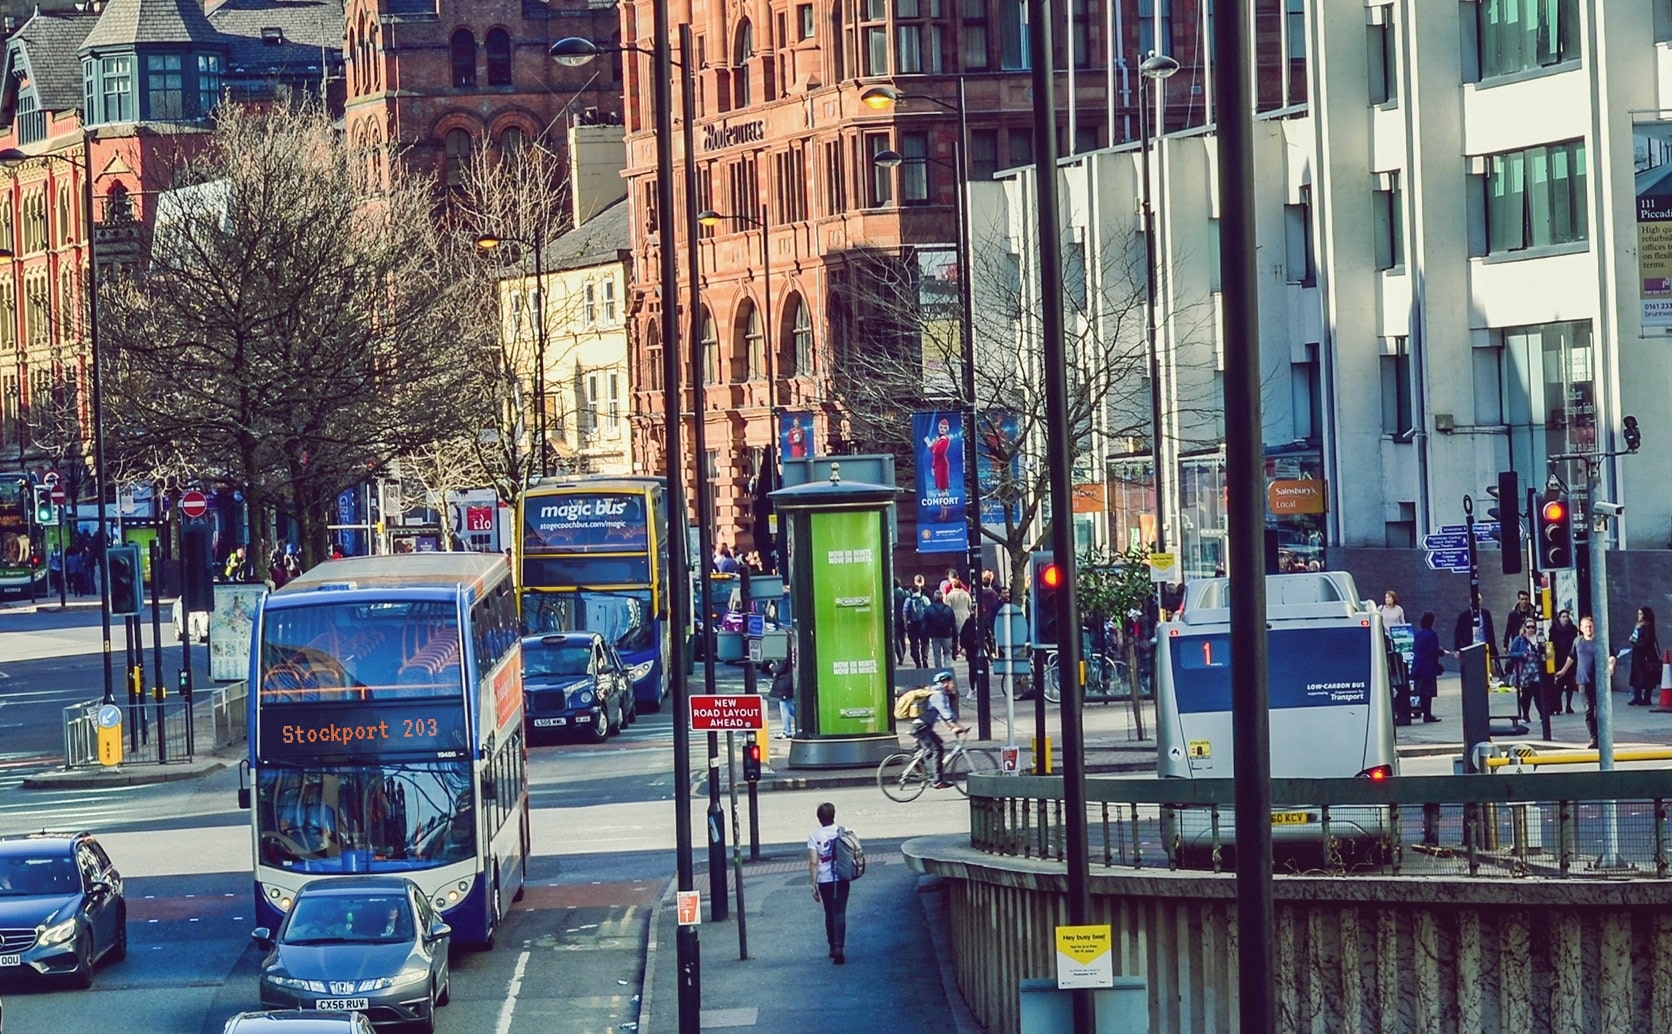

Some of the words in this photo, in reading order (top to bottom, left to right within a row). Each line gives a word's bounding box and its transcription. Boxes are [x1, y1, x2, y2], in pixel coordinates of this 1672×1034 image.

[1642, 200, 1654, 208] 111
[1642, 226, 1660, 234] High
[1276, 487, 1316, 496] Sainsbury's
[922, 497, 958, 506] COMFORT
[541, 500, 591, 520] magic
[595, 500, 624, 514] bus
[540, 521, 626, 531] stagecoachbus.com/magic
[1204, 642, 1210, 665] 1
[694, 709, 720, 717] ROAD
[723, 709, 759, 717] LAYOUT
[710, 719, 743, 727] AHEAD
[282, 720, 389, 746] Stockport
[403, 718, 438, 738] 203
[1285, 813, 1302, 822] KCV
[320, 1000, 344, 1010] CX56
[346, 1000, 364, 1008] RUV
